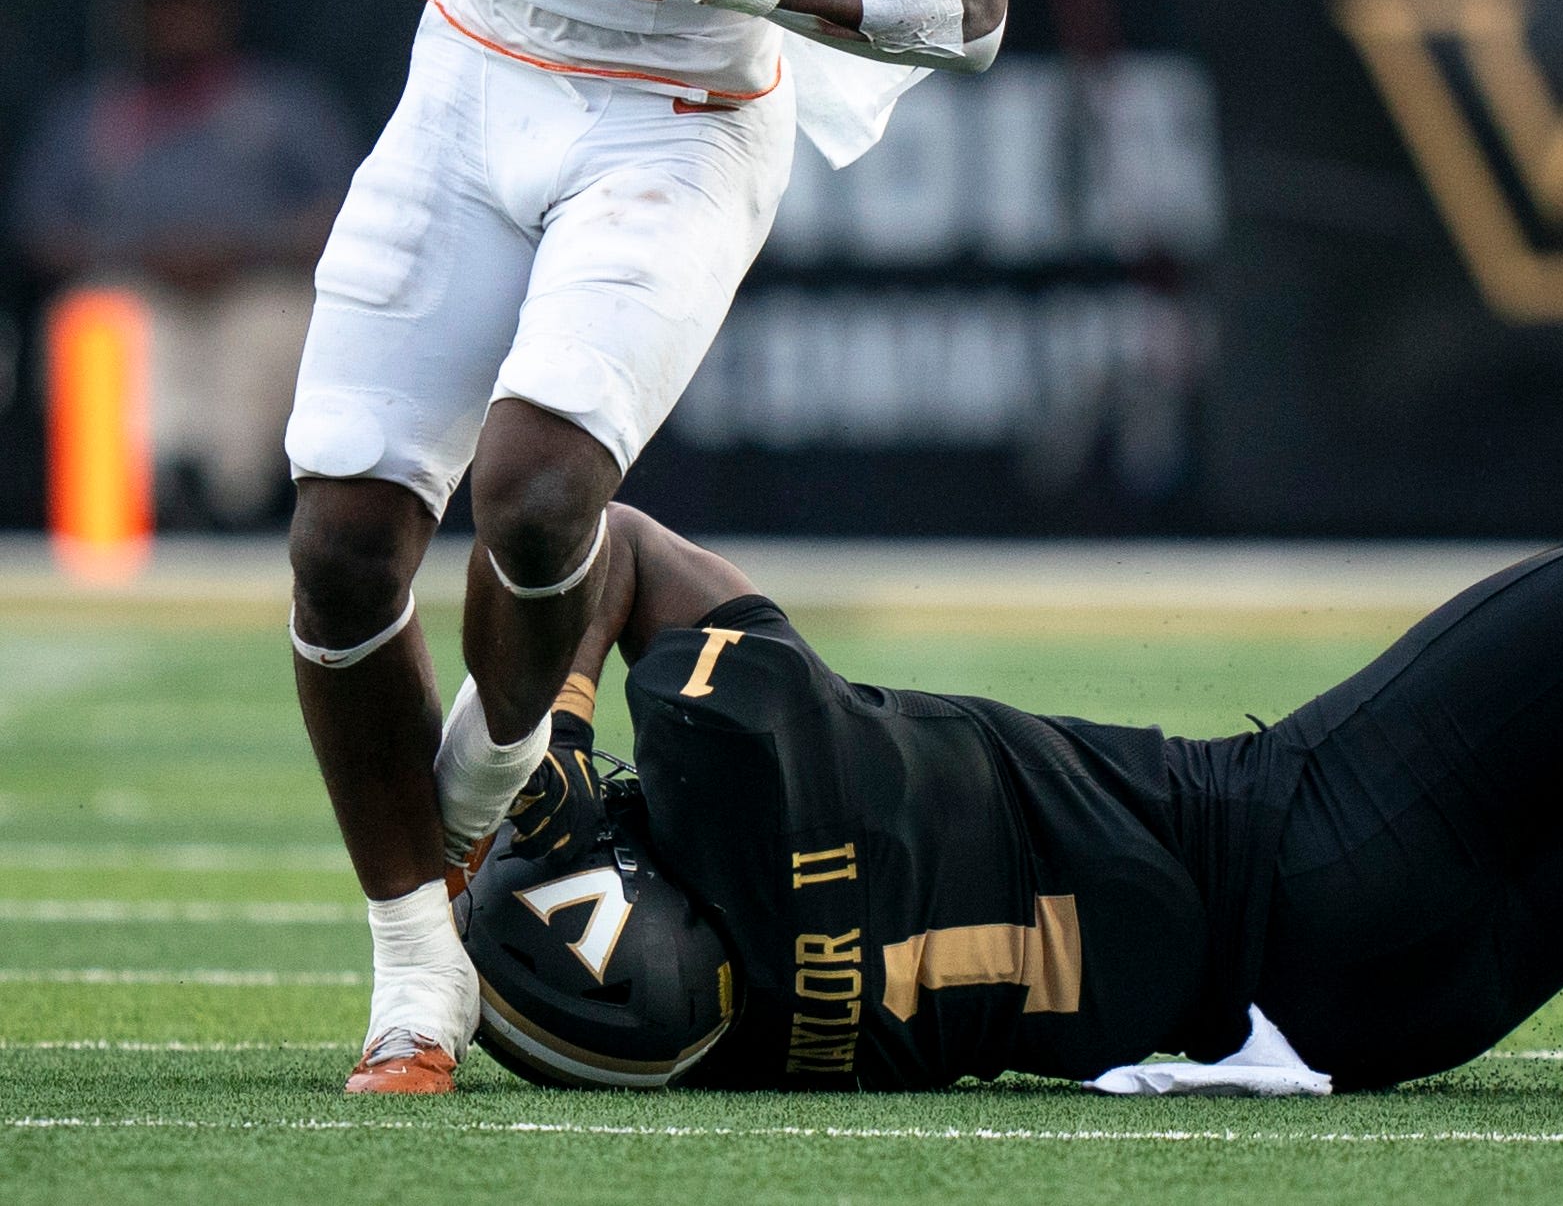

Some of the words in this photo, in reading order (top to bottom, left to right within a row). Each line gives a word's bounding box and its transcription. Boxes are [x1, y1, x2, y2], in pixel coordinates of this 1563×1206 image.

[792, 842, 858, 889] II
[786, 928, 862, 1074] TAYLOR
[882, 892, 1083, 1024] 1
